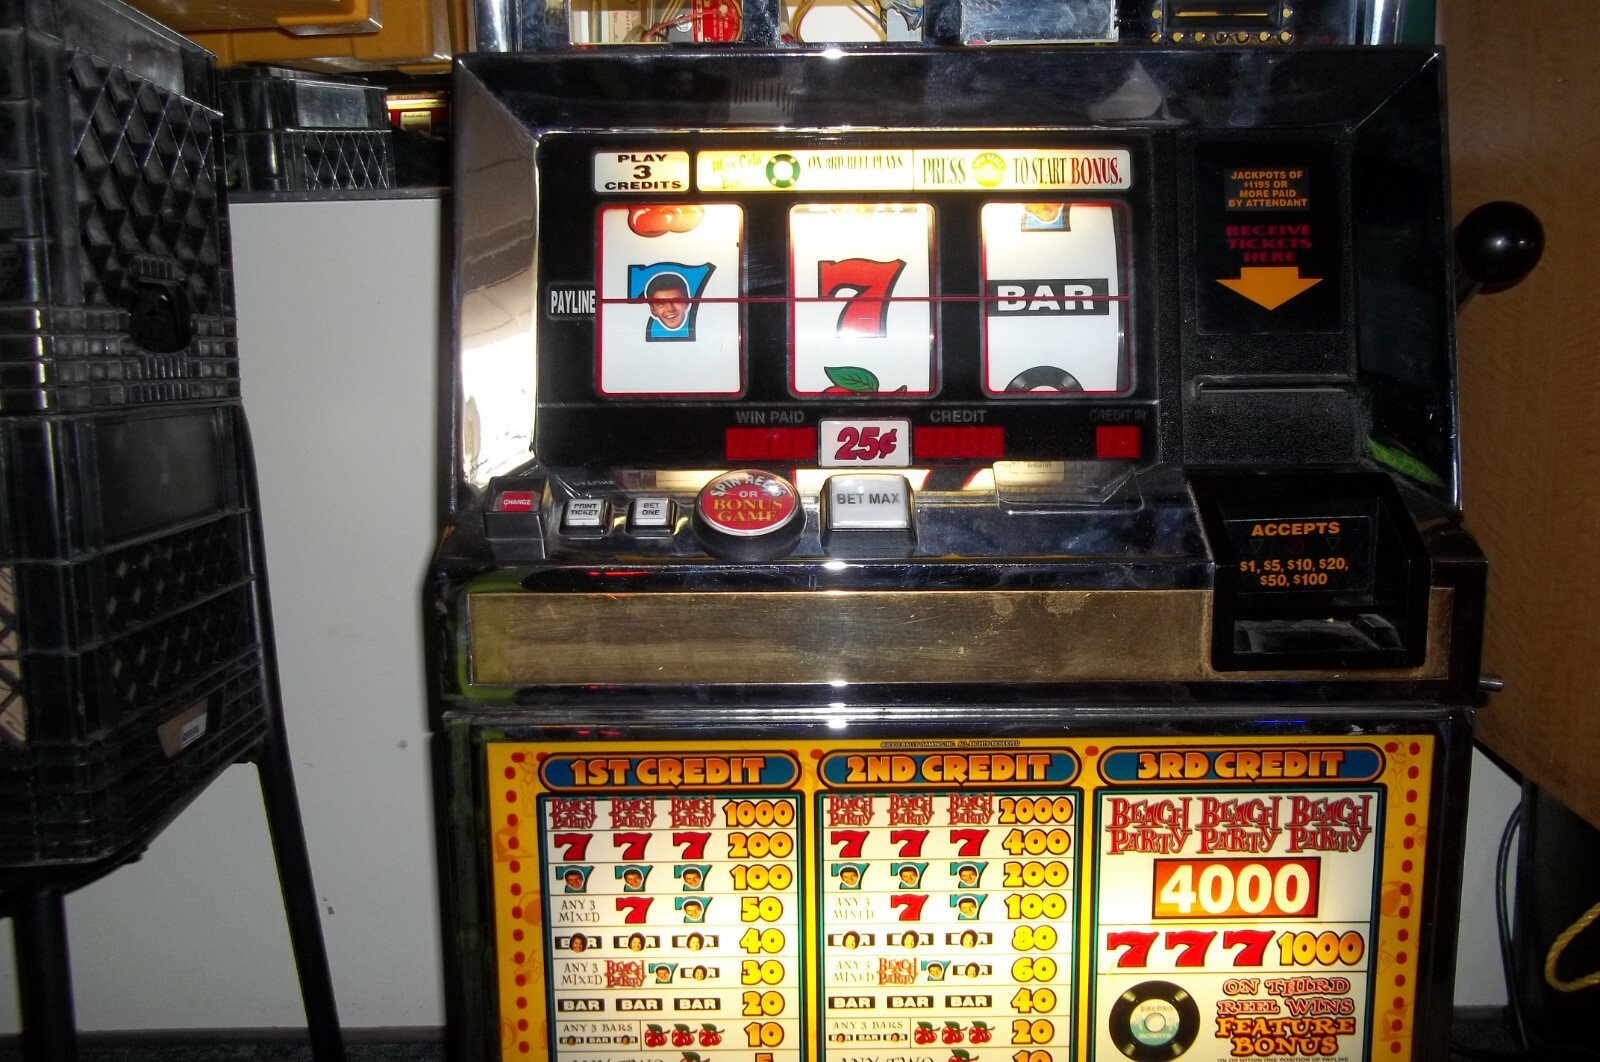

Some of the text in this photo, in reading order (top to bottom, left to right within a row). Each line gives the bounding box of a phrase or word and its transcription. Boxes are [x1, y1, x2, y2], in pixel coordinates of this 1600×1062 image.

[618, 154, 668, 163] PLAY
[808, 155, 822, 169] ON
[825, 155, 843, 170] 3RD
[873, 155, 904, 169] PLAYS
[633, 165, 651, 179] 3
[922, 157, 966, 184] PRESS
[1013, 157, 1029, 184] TO
[1032, 157, 1067, 184] START
[1070, 157, 1123, 185] BONUS.
[1231, 171, 1303, 179] JACKPOTS OF
[605, 181, 682, 190] CREDITS
[1273, 180, 1288, 188] OR
[1228, 199, 1308, 207] BY ATTENDANT
[1226, 225, 1312, 236] RECEIVE
[1227, 238, 1312, 249] TICKETS
[1243, 252, 1297, 262] HERE
[551, 290, 596, 314] PAYLINE
[818, 258, 907, 338] 7
[997, 284, 1094, 311] BAR
[736, 411, 805, 424] WIN PAID
[930, 410, 987, 422] CREDIT
[1088, 409, 1148, 422] CREDIT IN
[834, 426, 898, 460] 25¢
[709, 477, 742, 498] SPIN
[739, 490, 758, 498] OR
[713, 499, 783, 510] BONUS
[836, 493, 900, 505] BET MAX
[718, 511, 778, 522] GAME
[1251, 522, 1340, 536] ACCEPTS
[1240, 557, 1349, 574] $1, $5, $10, $20,
[1260, 573, 1327, 587] $50, $100
[570, 757, 766, 788] 1ST CREDIT
[846, 753, 1052, 785] 2ND CREDIT
[1137, 750, 1345, 782] 3RD CREDIT
[722, 800, 795, 827] 1000
[998, 797, 1073, 824] 2000
[1106, 795, 1373, 829] BEACH BEACH BEACH
[553, 831, 793, 861] 7 7 7 200
[830, 828, 1071, 858] 7 7 7 400
[1105, 825, 1372, 855] PARTY PARTY PARTY
[729, 863, 793, 891] 100
[1002, 860, 1070, 888] 200
[1160, 863, 1310, 914] 4000
[561, 899, 596, 911] ANY 3
[615, 896, 784, 924] 7 50
[836, 897, 859, 907] ANY
[890, 892, 1067, 921] 7 100
[558, 912, 600, 923] MIXED
[739, 927, 786, 954] 40
[1012, 925, 1057, 951] 80
[1107, 930, 1364, 968] 7 7 7 1000
[564, 963, 599, 973] ANY 3
[741, 959, 785, 985] 30
[836, 960, 860, 970] ANY
[1011, 957, 1057, 982] 60
[561, 974, 602, 985] MIXED
[833, 971, 874, 982] MIXED
[1223, 976, 1351, 997] ON THIRD
[563, 990, 785, 1016] BAR BAR BAR 20
[833, 987, 1057, 1014] BAR BAR BAR 40
[1217, 997, 1356, 1016] REEL WINS
[563, 1023, 633, 1033] ANY 3 BARS
[743, 1021, 785, 1047] 10
[833, 1021, 903, 1030] ANY 3 BARS
[1011, 1019, 1055, 1044] 20
[1215, 1016, 1356, 1038] FEATURE
[1230, 1035, 1339, 1056] BONUS
